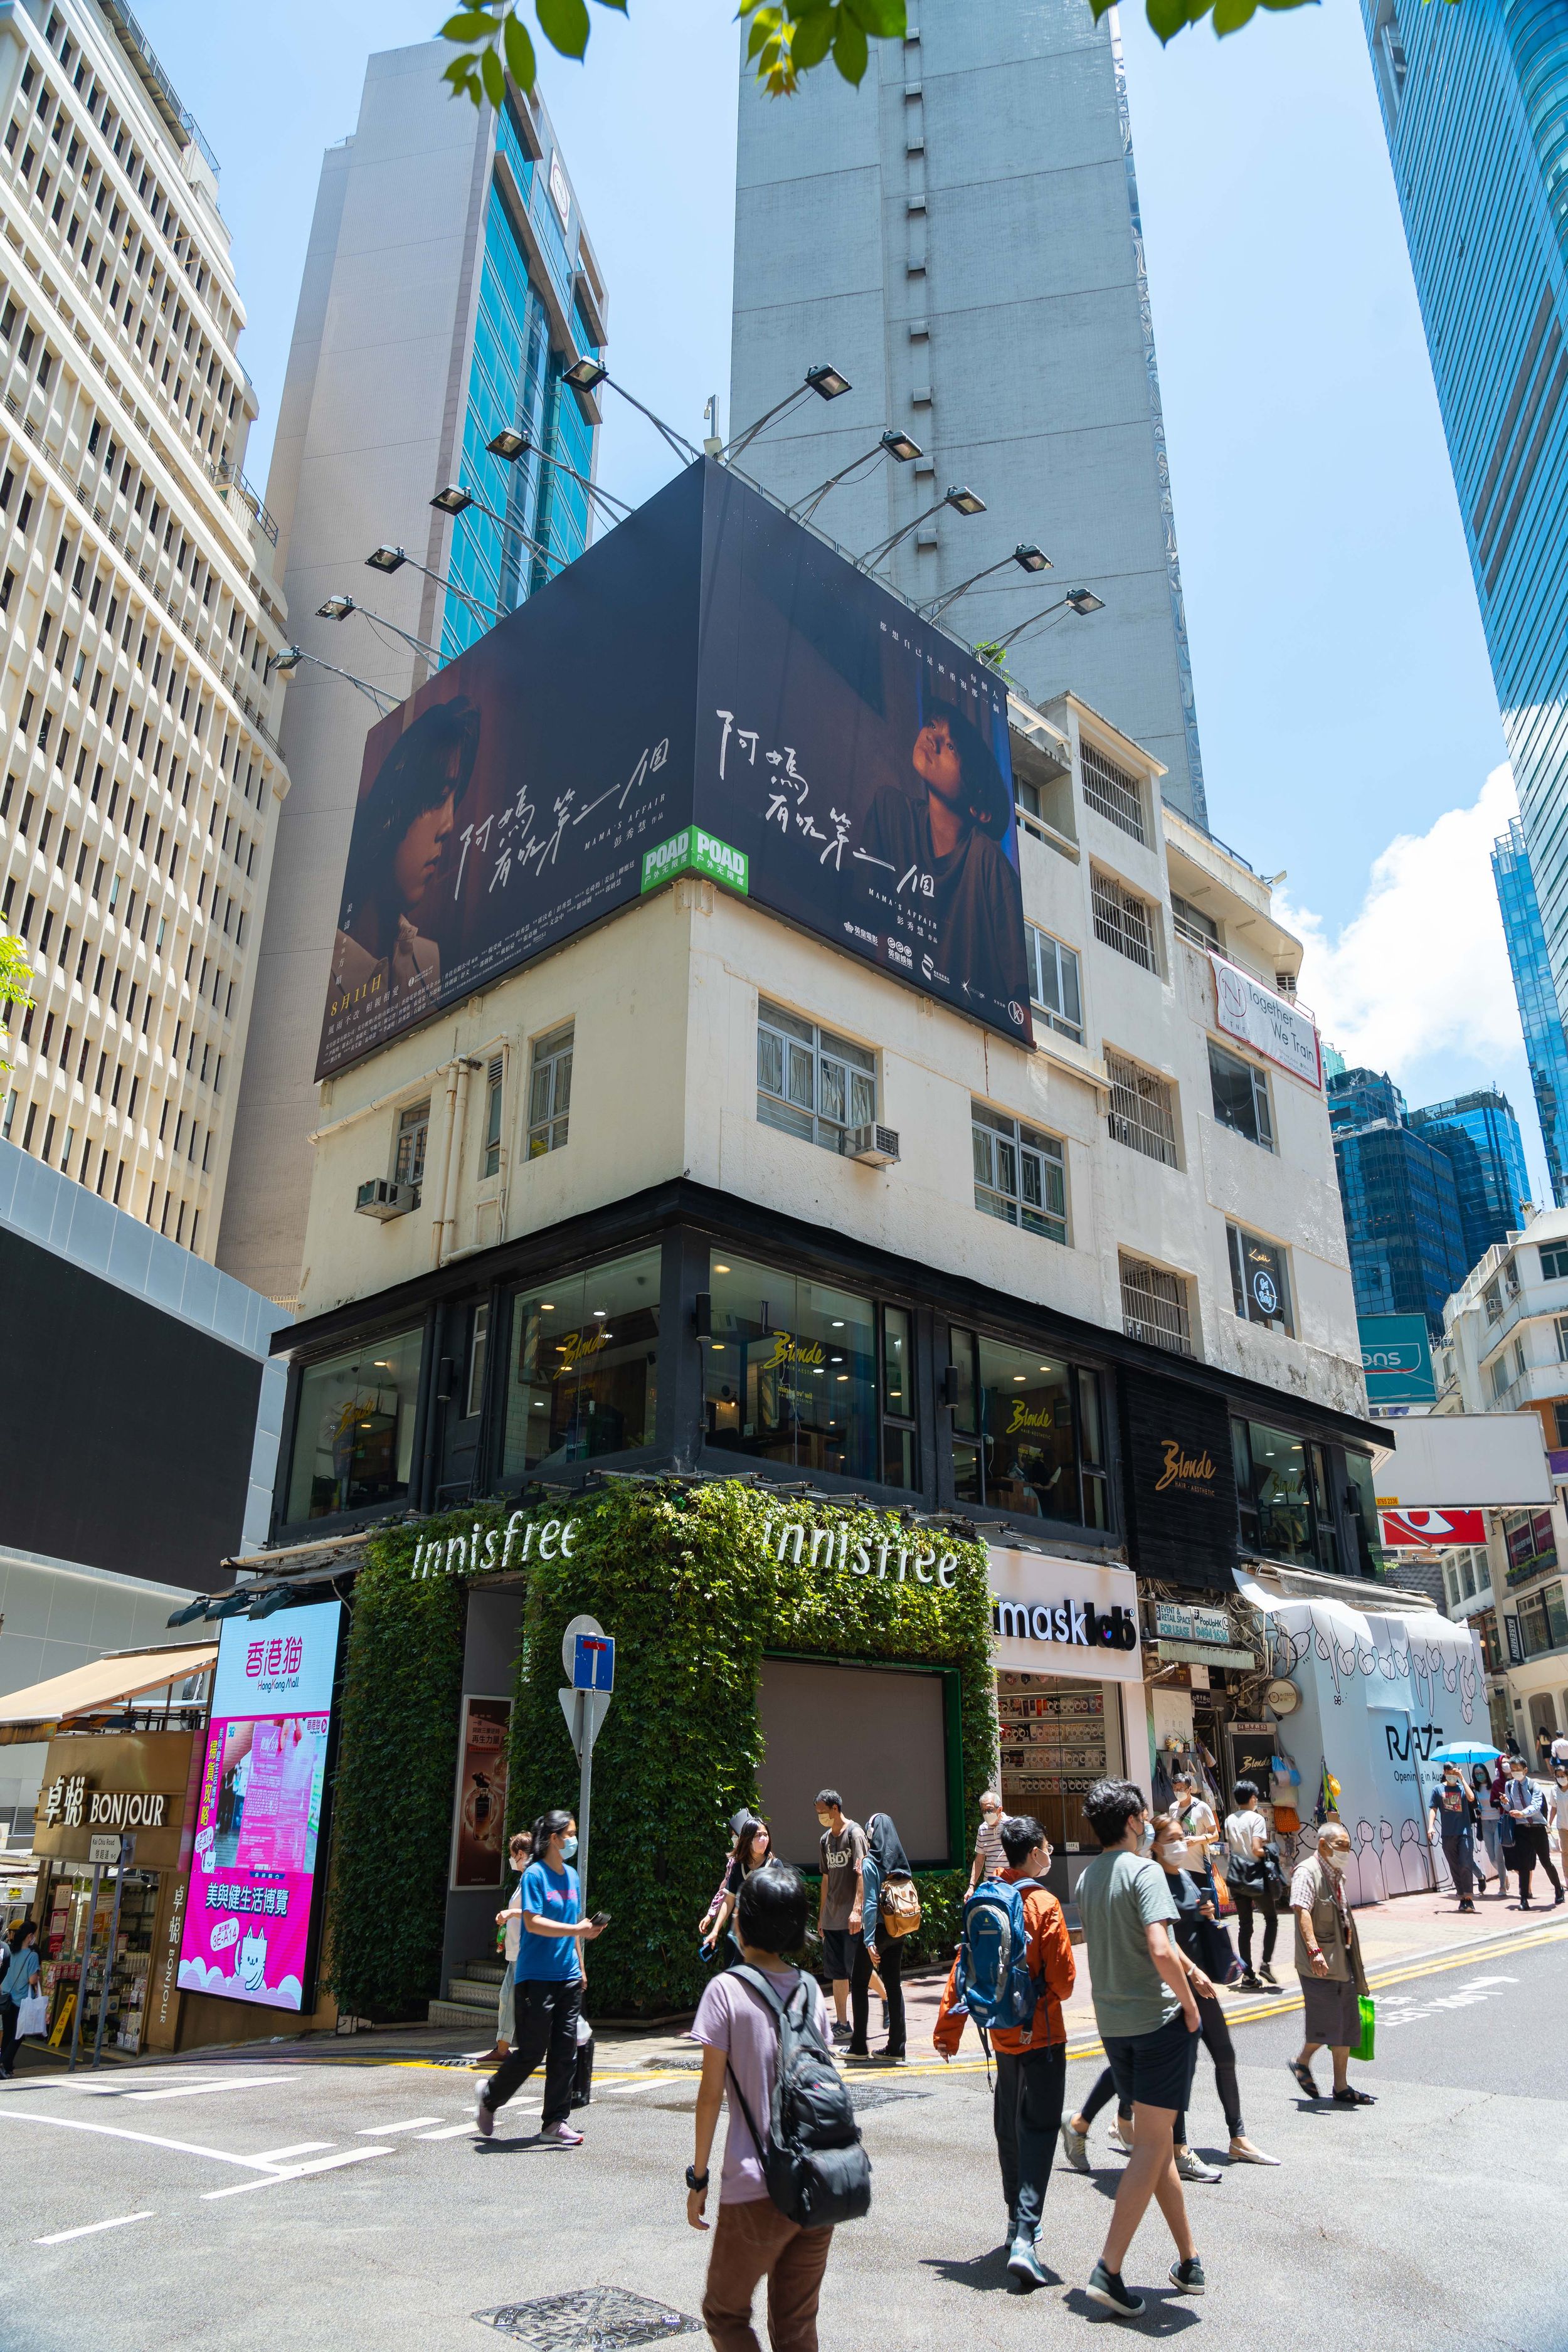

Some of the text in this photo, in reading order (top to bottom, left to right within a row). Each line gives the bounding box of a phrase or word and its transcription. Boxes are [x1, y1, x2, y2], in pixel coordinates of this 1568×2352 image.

[584, 793, 665, 851] MAMA'S AFFAIR
[613, 820, 646, 849] 彭秀慧
[645, 832, 689, 875] POAD
[697, 832, 744, 876] POAD
[869, 887, 937, 930] MAMA'S AFFAIR
[896, 915, 924, 937] 彭秀慧
[328, 1009, 360, 1036] 風雨不改
[366, 985, 400, 1014] 相親相愛
[331, 974, 381, 1017] 8月11日
[1246, 982, 1293, 1028] Together
[1271, 1018, 1288, 1046] We
[1291, 1032, 1314, 1064] Train
[763, 1331, 827, 1369] Blonde
[1006, 1399, 1052, 1434] Blonde
[1155, 1439, 1216, 1491] Blonde
[1175, 1480, 1215, 1497] HAIR AESTHETIC
[411, 1510, 583, 1580] innisfree
[762, 1520, 958, 1589] innisfree
[1160, 1605, 1175, 1614] EVENT
[1176, 1608, 1180, 1616] &
[1161, 1614, 1191, 1625] RETAIL SPACE
[1200, 1616, 1222, 1629] PopUpHK
[1160, 1623, 1190, 1638] FOR LEASE
[1507, 1618, 1520, 1660] BASEMENT
[257, 1677, 299, 1693] HongKong Mall
[1239, 1756, 1271, 1774] Blonde
[1394, 1771, 1425, 1784] Opening
[1424, 1771, 1431, 1782] in
[89, 1794, 164, 1831] BONJOUR
[205, 1882, 290, 1916] 美與健生活博覽
[213, 1928, 237, 1948] 3E-A14
[159, 1949, 175, 2024] BONJOUR
